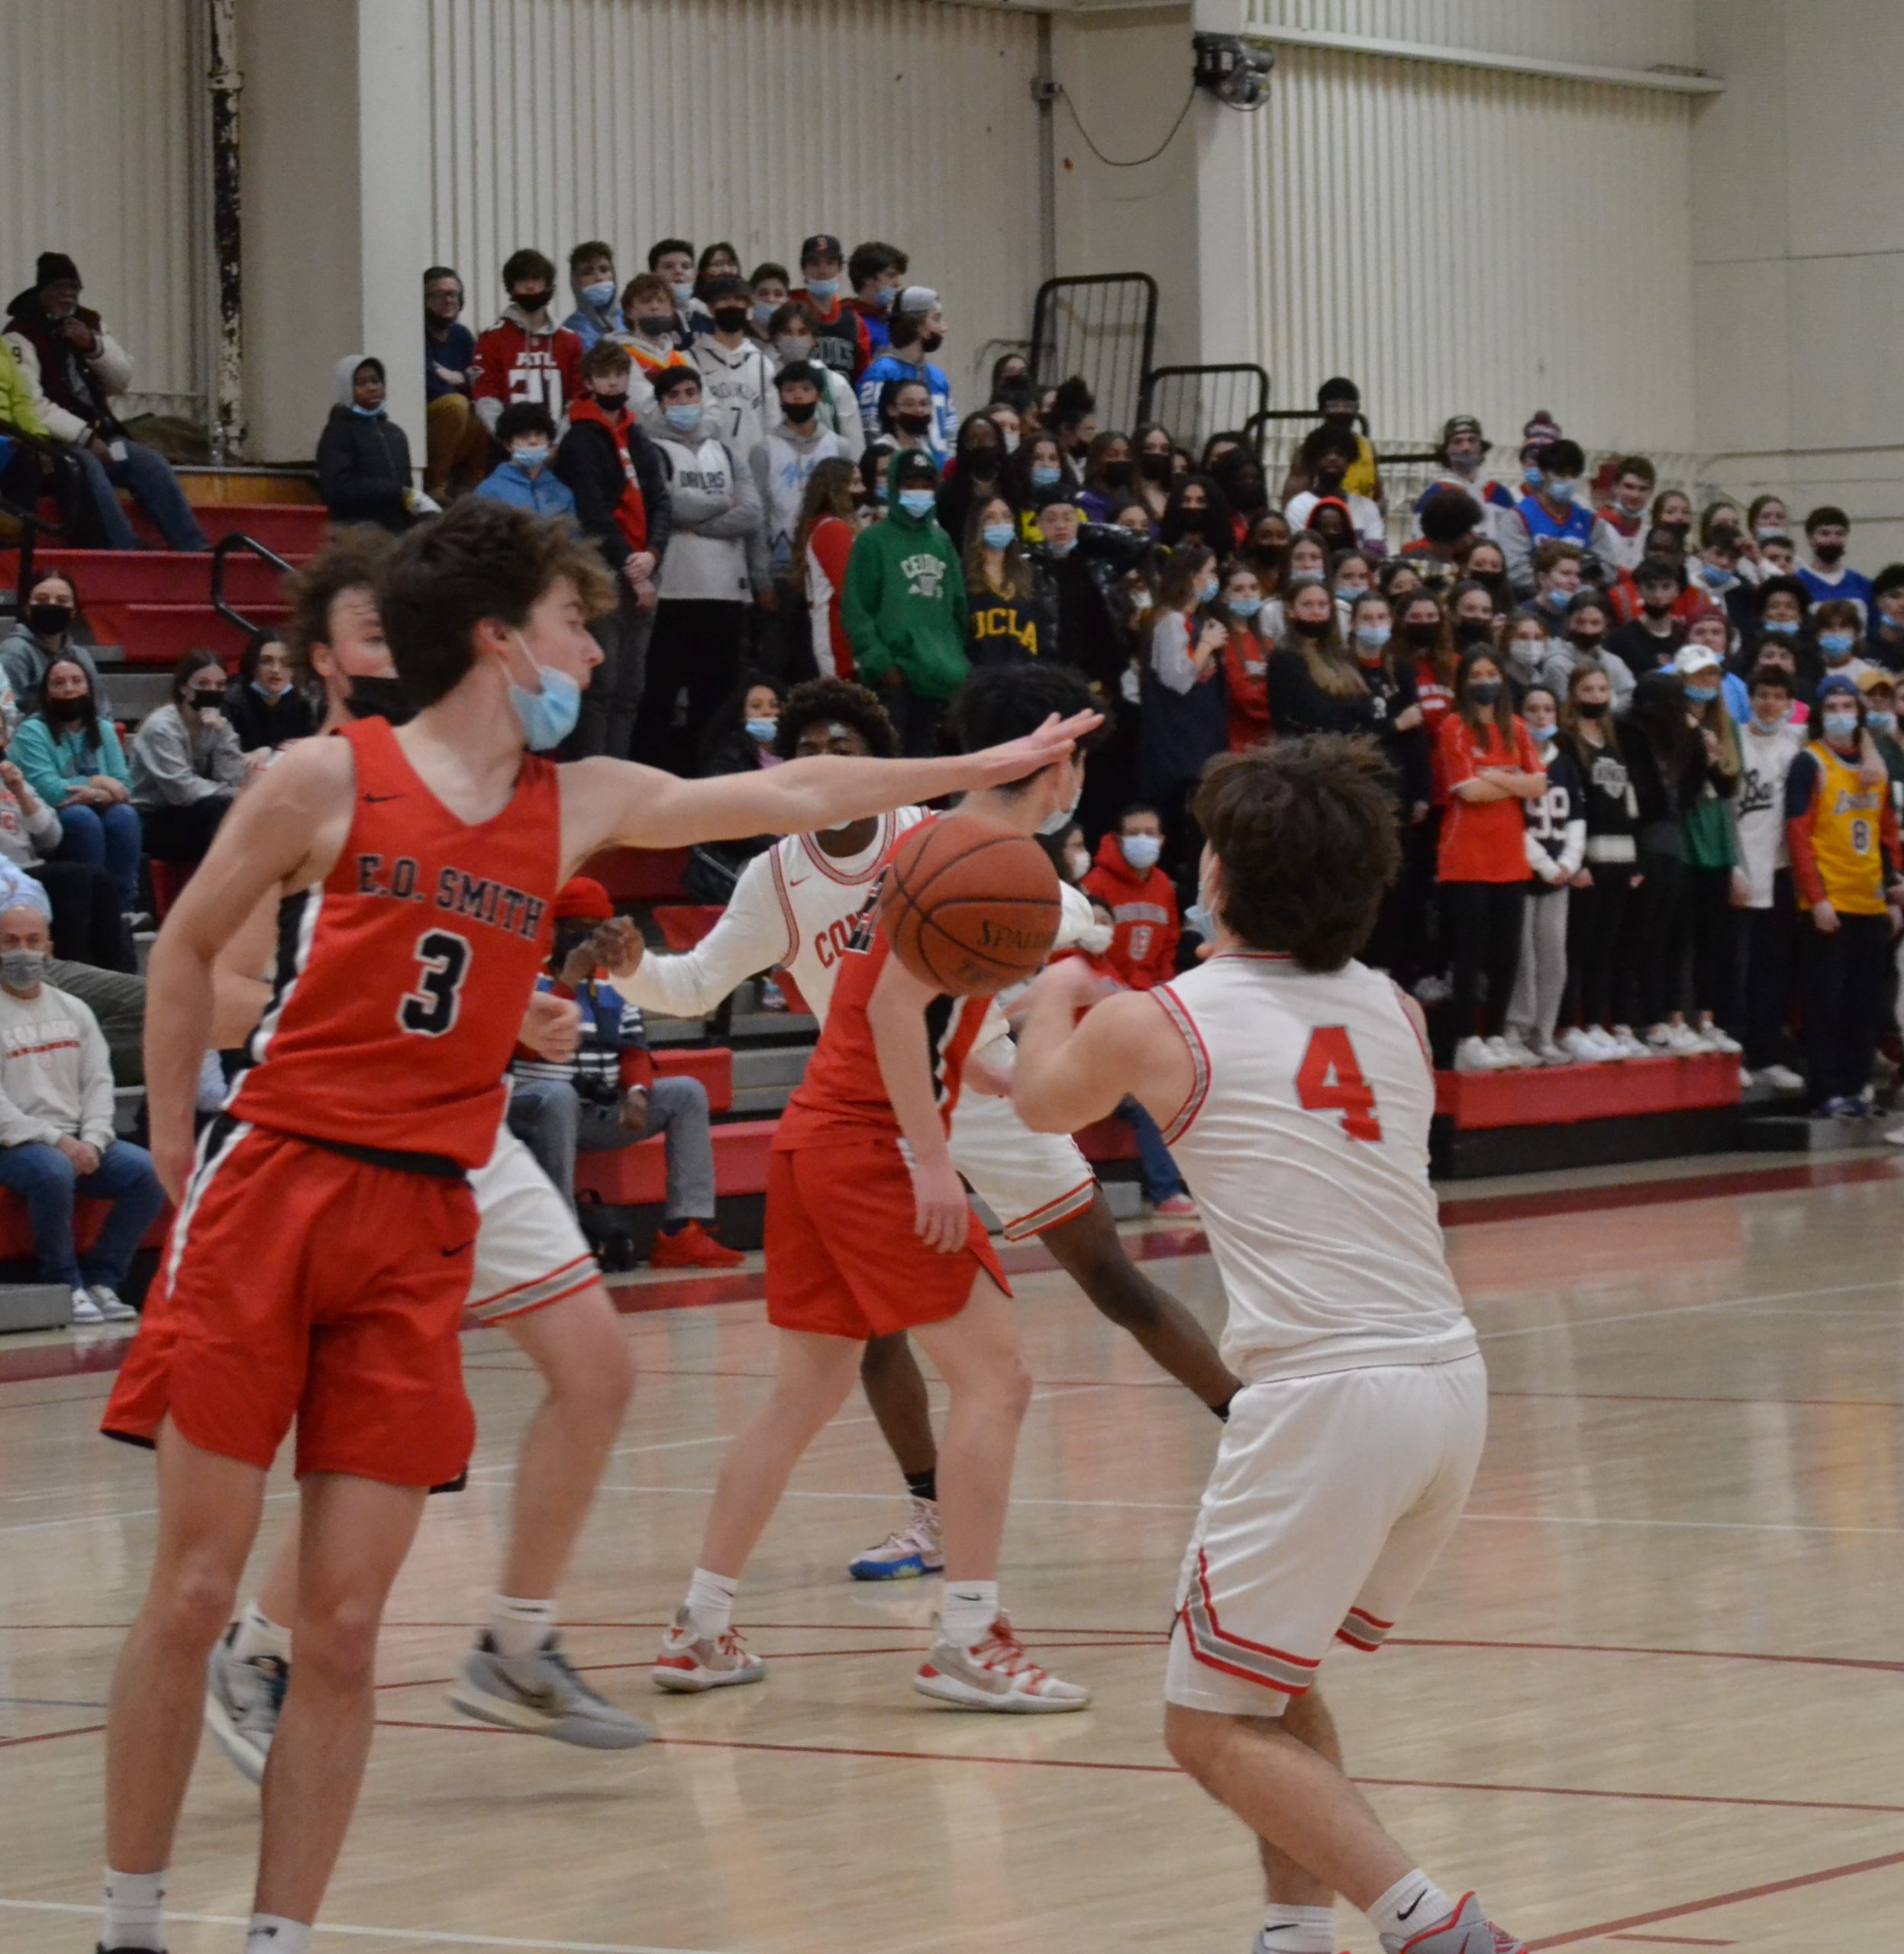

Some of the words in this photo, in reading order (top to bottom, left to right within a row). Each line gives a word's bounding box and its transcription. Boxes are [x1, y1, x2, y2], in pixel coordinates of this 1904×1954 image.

[516, 352, 557, 366] ATL
[731, 405, 742, 437] 7
[1851, 818, 1870, 855] 8
[357, 853, 424, 904] E.O.
[434, 866, 546, 943] SMITH
[395, 927, 474, 1039] 3
[1292, 1023, 1384, 1143] 4
